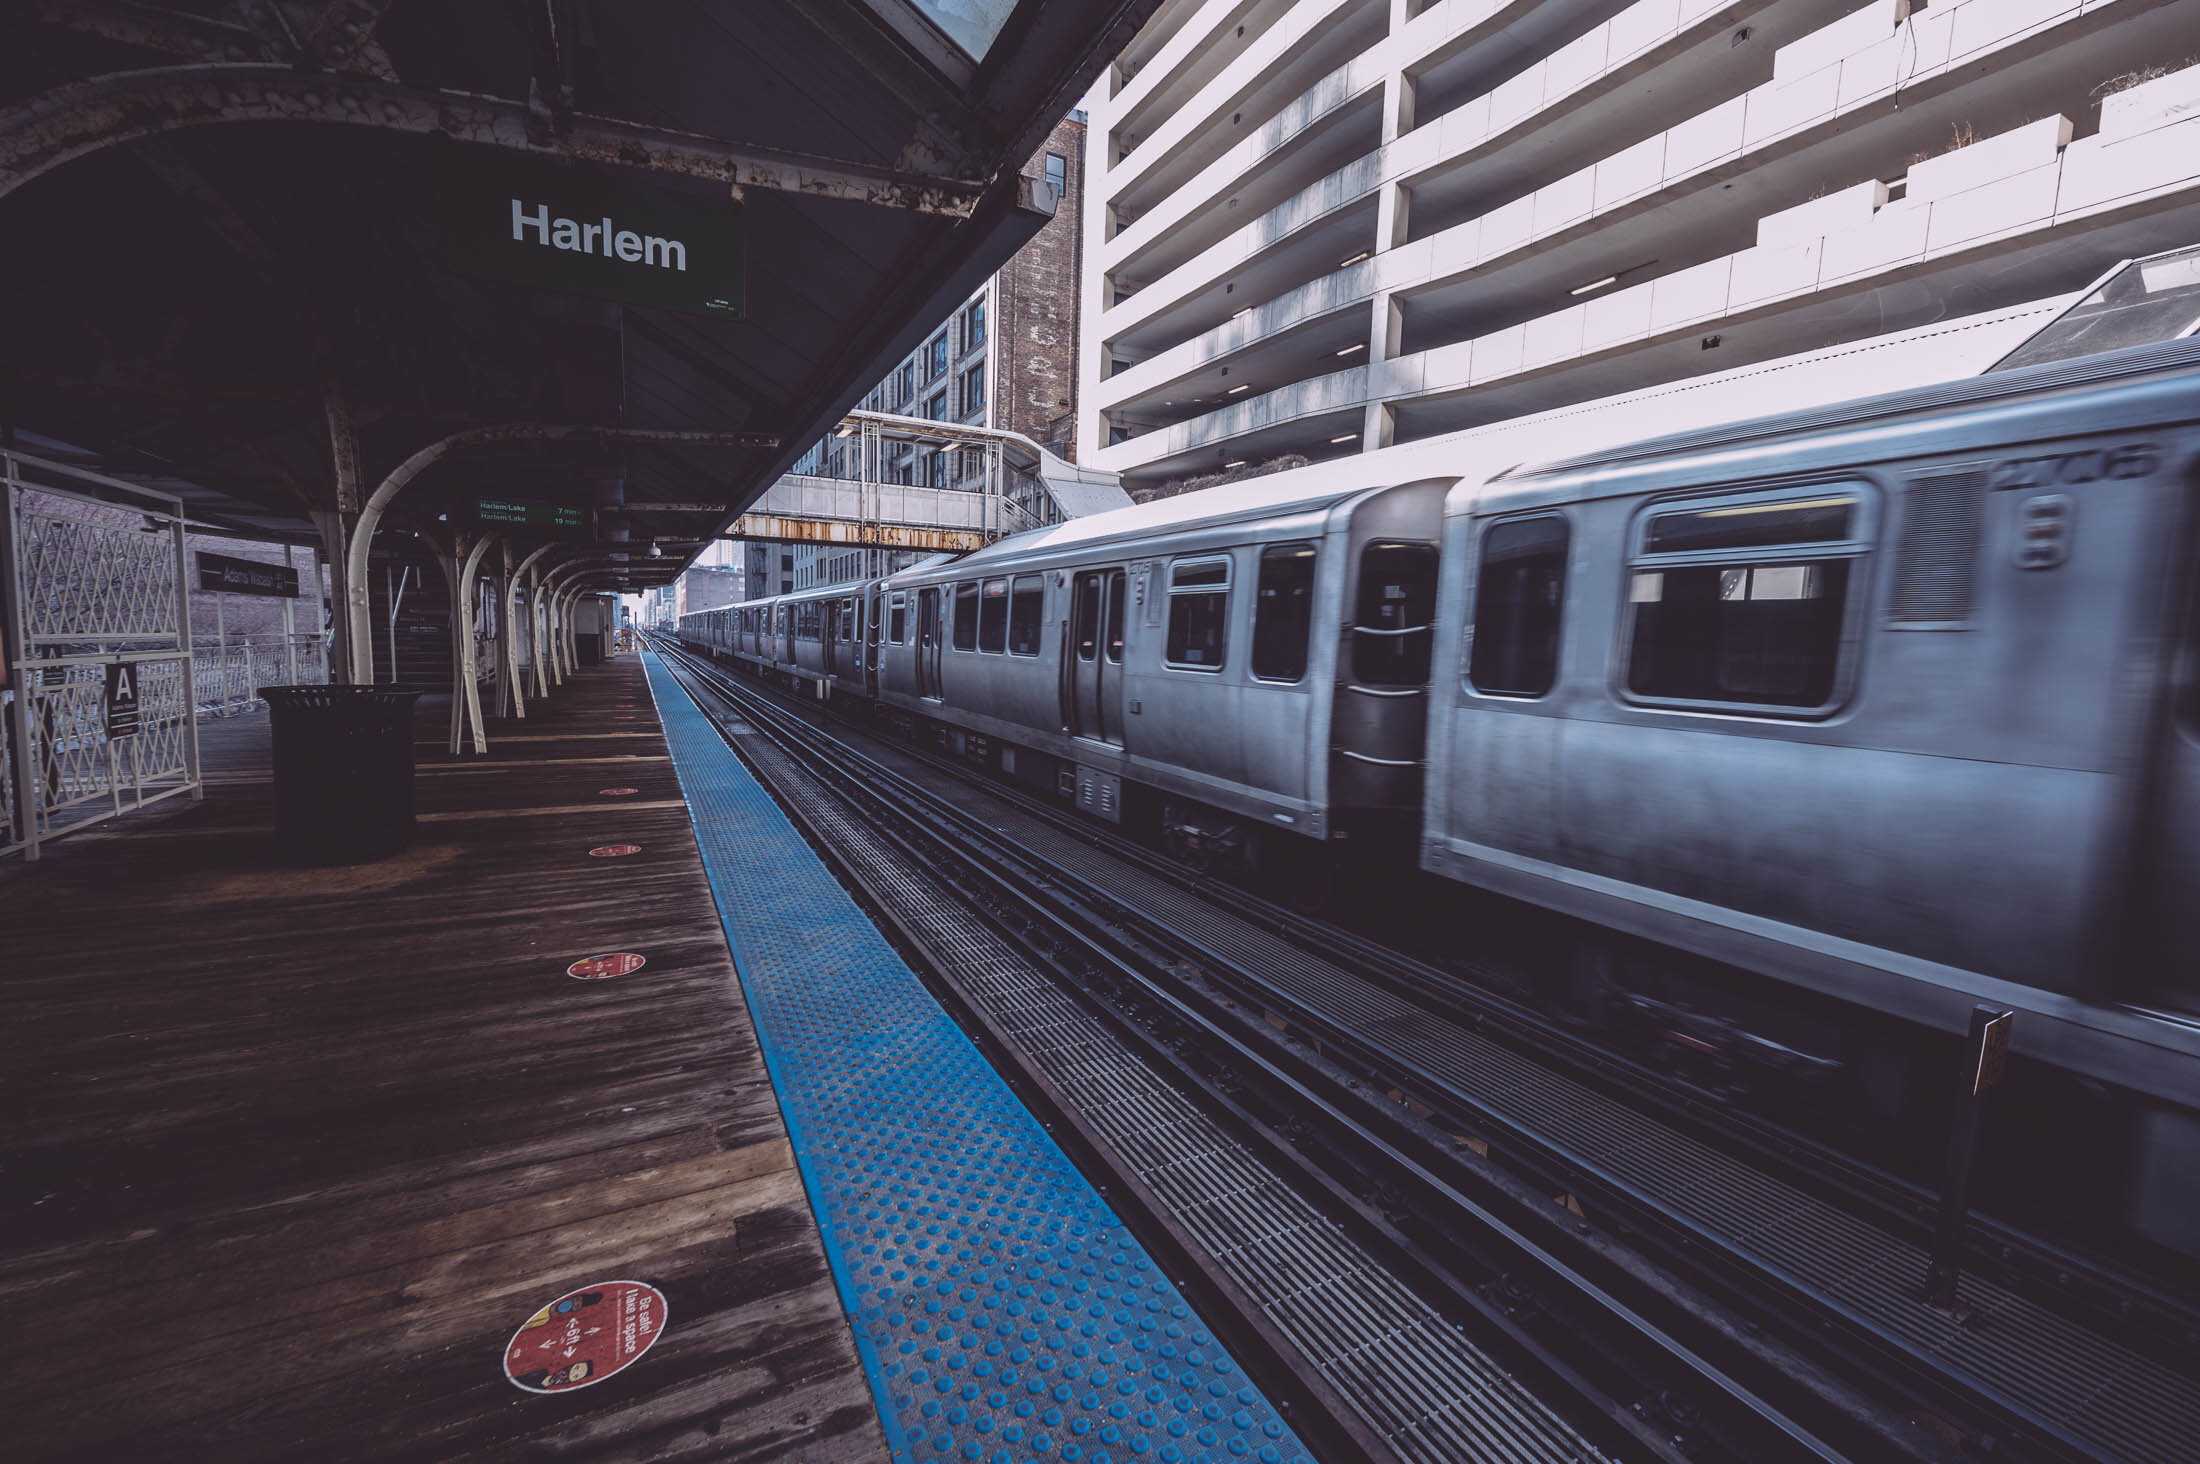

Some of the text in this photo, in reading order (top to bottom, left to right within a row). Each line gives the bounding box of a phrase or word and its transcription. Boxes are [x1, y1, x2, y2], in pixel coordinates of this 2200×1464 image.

[511, 198, 687, 271] Harlem
[116, 667, 132, 701] A
[625, 1314, 636, 1322] a
[640, 1296, 653, 1336] Be safe!
[566, 1328, 580, 1346] 6ft
[622, 1322, 636, 1355] space
